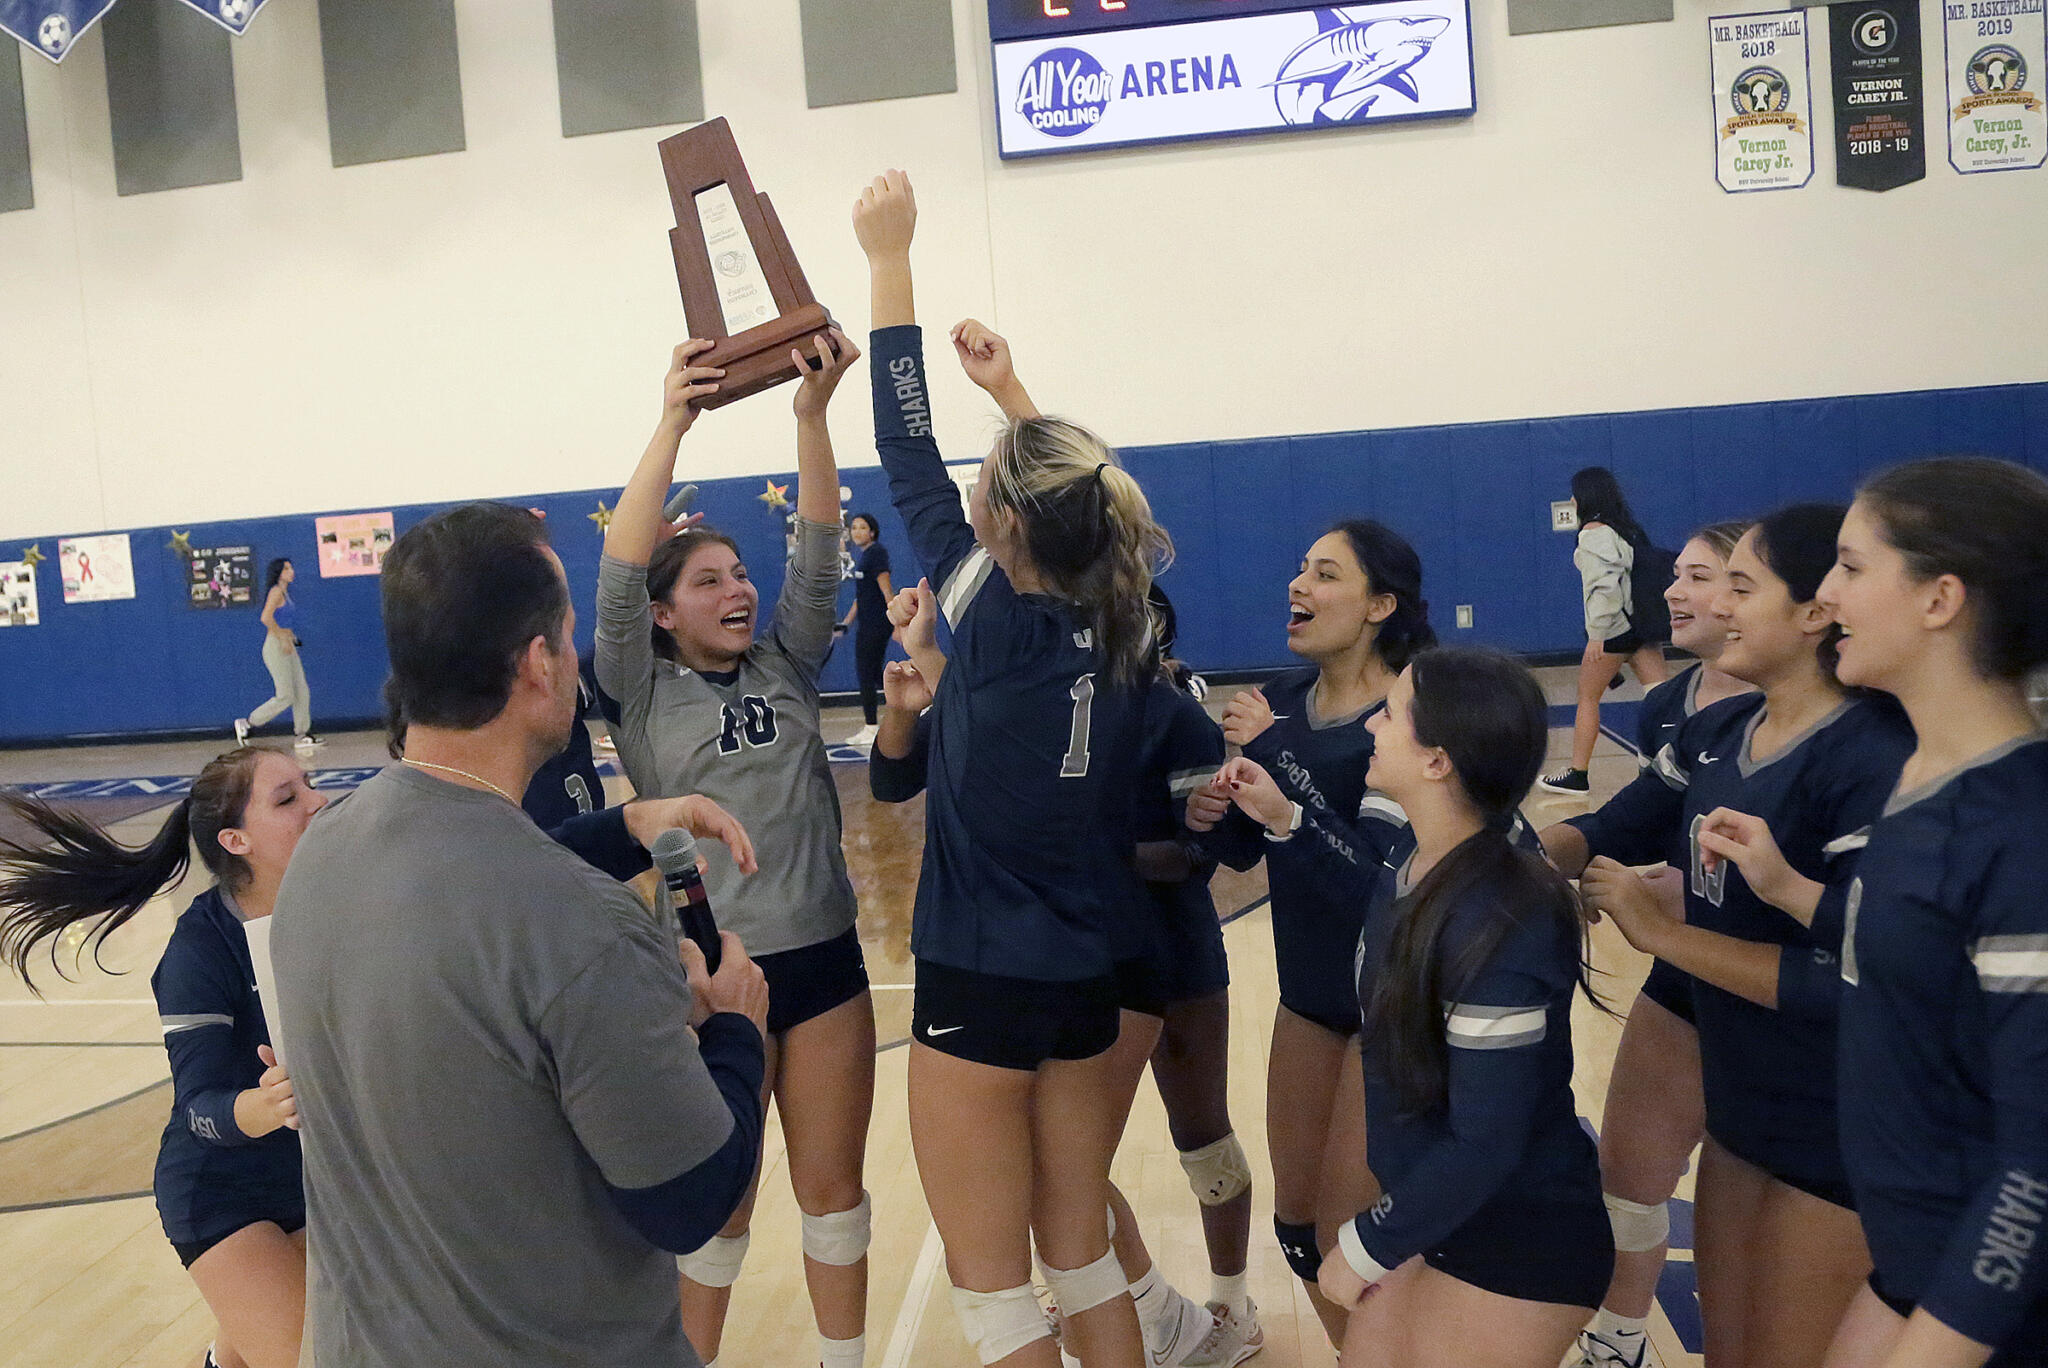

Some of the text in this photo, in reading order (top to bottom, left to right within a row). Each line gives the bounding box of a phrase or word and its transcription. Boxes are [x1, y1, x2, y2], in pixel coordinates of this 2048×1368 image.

[1948, 0, 2042, 20] MR. BASKETBALL
[1714, 20, 1801, 42] MR. BASKETBALL
[1861, 18, 1886, 47] G
[1977, 18, 2012, 36] 2019
[1741, 40, 1775, 58] 2018
[1014, 57, 1113, 113] All Year
[1120, 53, 1241, 99] ARENA
[1852, 79, 1902, 91] VERNON
[1847, 91, 1908, 104] CAREY JR.
[1962, 97, 2033, 110] SPORTS AWARDS
[1031, 106, 1100, 129] COOLING
[1728, 117, 1796, 129] SPORTS AWARDS
[1973, 119, 2023, 133] Vernon
[1738, 139, 1787, 153] Vernon
[1850, 140, 1882, 155] 2018
[1894, 137, 1909, 151] 19
[1966, 134, 2031, 154] Carey, Jr.
[1734, 154, 1793, 174] Carey Jr.
[889, 356, 932, 438] SHARKS
[716, 694, 780, 756] 10
[1060, 673, 1096, 777] 1
[1973, 1168, 2048, 1290] HARKS
